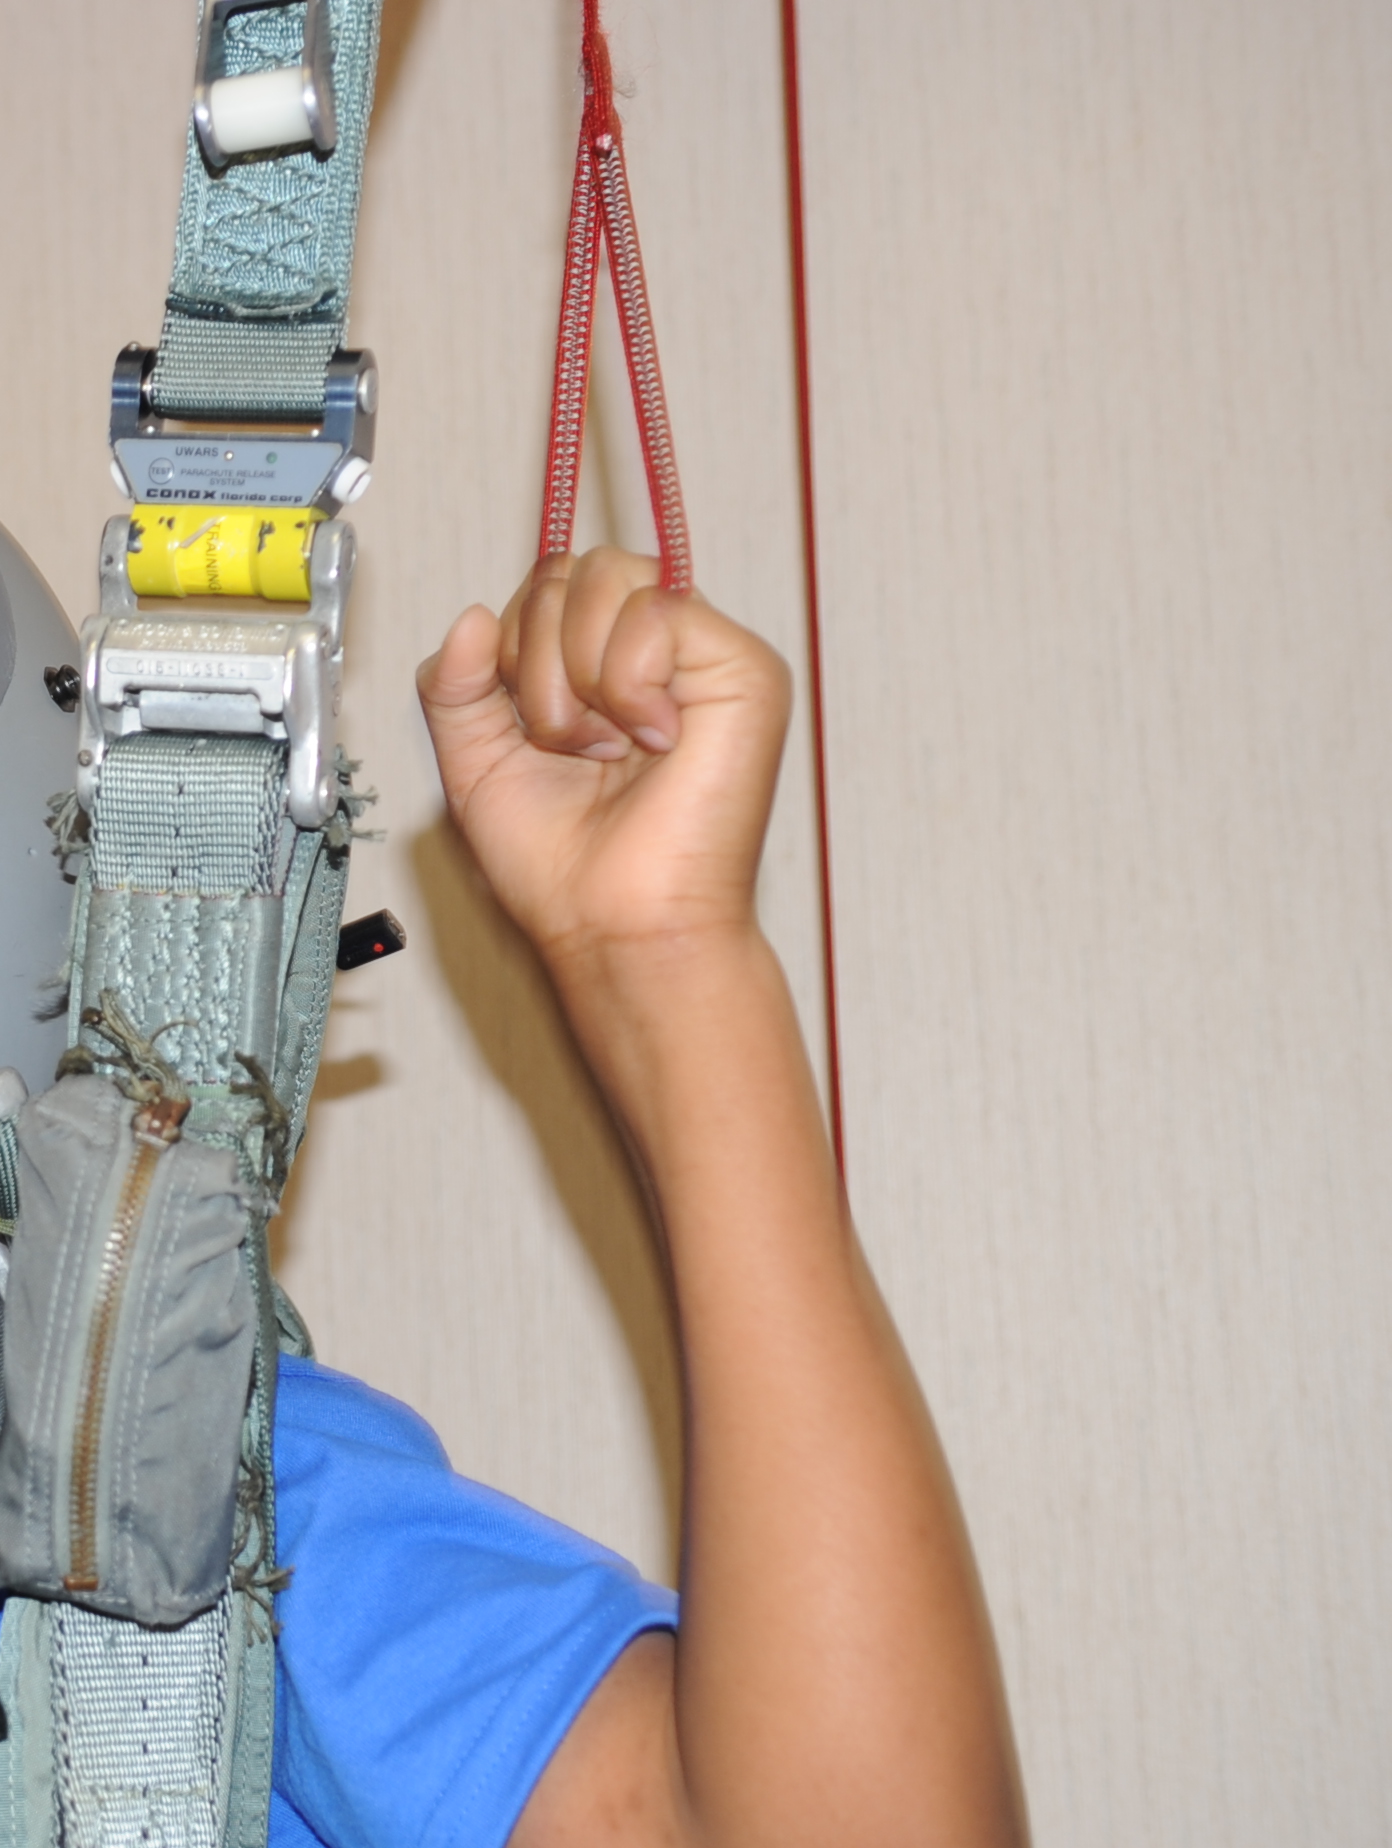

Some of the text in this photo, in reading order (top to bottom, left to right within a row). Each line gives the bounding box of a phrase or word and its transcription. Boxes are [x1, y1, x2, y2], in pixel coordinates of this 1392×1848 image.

[175, 446, 219, 457] UWARS
[151, 466, 171, 475] TEST
[180, 468, 276, 478] PARACHUTE RELEASE
[209, 478, 246, 486] SYSTEM
[270, 494, 303, 503] corp
[205, 522, 222, 591] TRAINING
